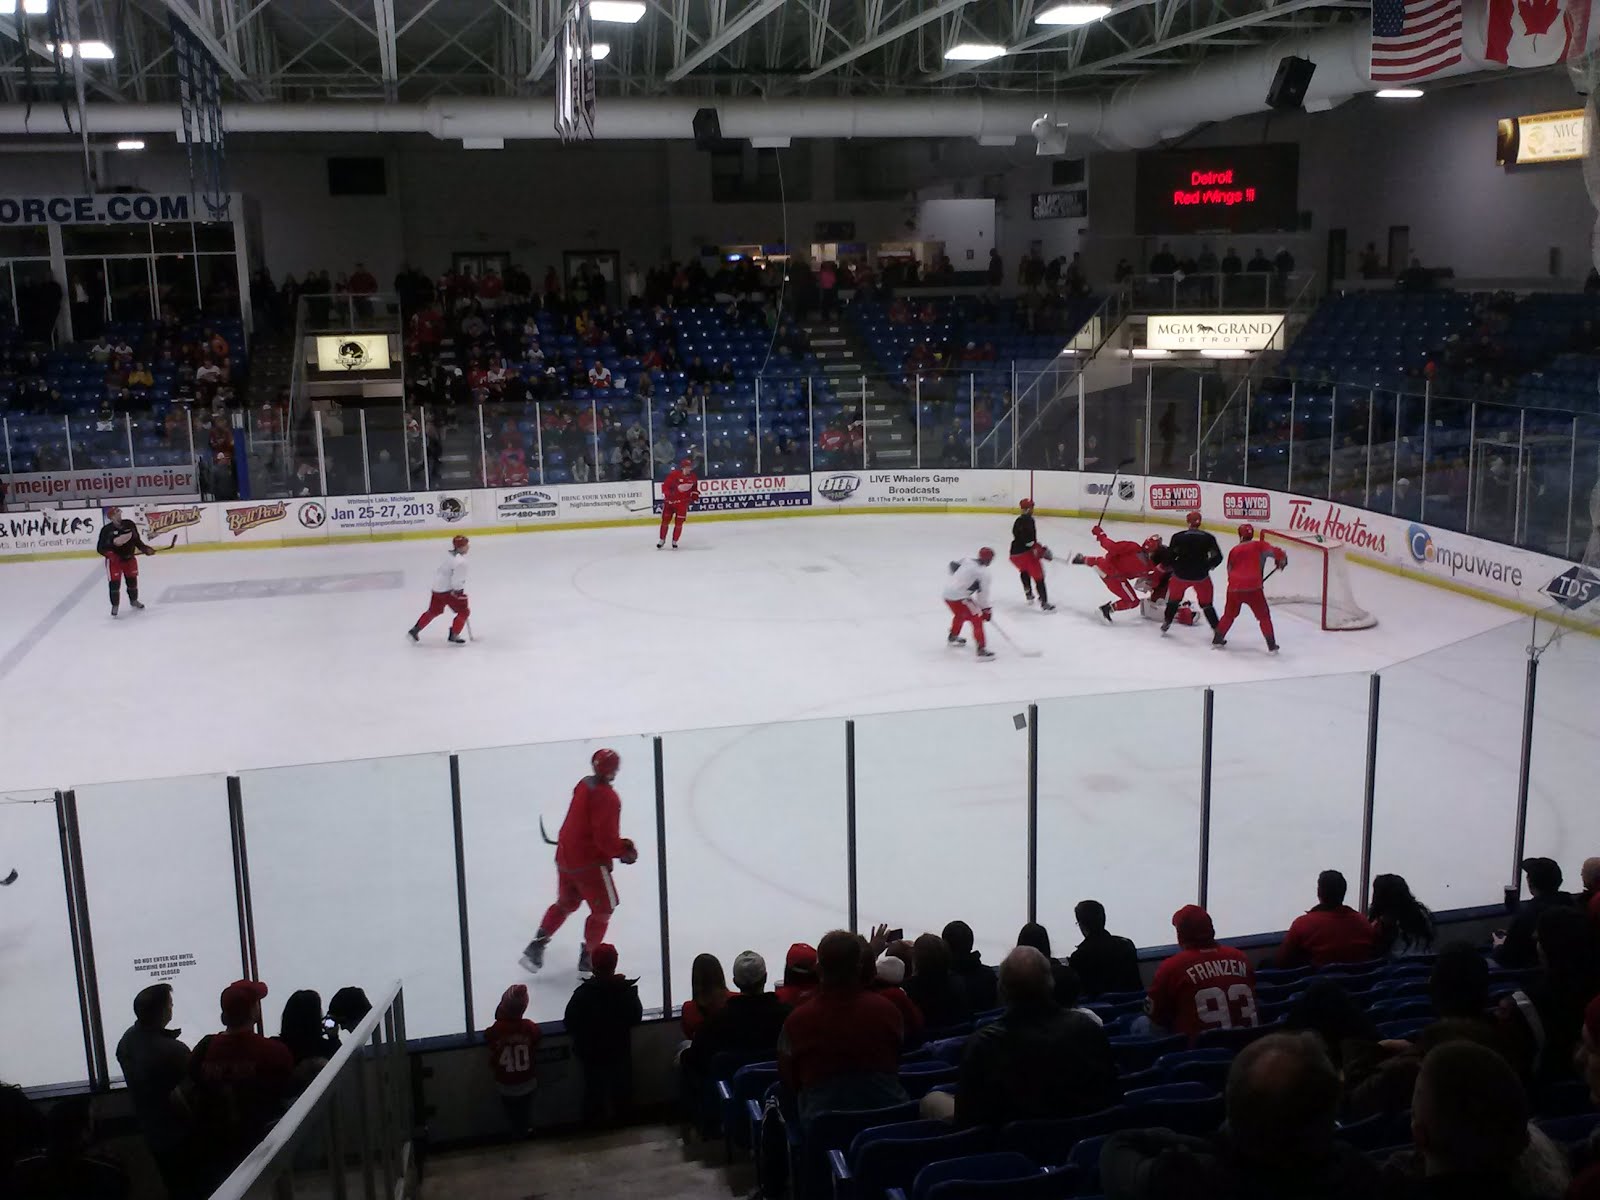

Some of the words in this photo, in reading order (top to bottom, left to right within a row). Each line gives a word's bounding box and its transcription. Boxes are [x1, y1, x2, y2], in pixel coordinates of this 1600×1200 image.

[1191, 169, 1234, 186] Detroit
[1173, 190, 1200, 205] Red
[1202, 189, 1242, 206] Wings
[0, 196, 188, 223] ORCE.COM
[1157, 324, 1193, 334] MGM
[1217, 323, 1272, 334] GRAND
[15, 476, 71, 496] meijer
[76, 473, 132, 493] meijer
[137, 470, 192, 490] meijer
[699, 477, 786, 491] OCKEY.COM
[869, 475, 891, 483] LIVE
[892, 474, 930, 483] Whalers
[932, 474, 960, 484] Game
[504, 490, 552, 503] HIGHLAND
[889, 486, 941, 494] Broadcasts
[1152, 487, 1171, 499] 99.5
[1173, 487, 1198, 499] WYCD
[700, 502, 748, 510] HOCKEY
[755, 498, 809, 507] LEAGUES
[1225, 496, 1243, 508] 99.5
[1245, 496, 1268, 509] WYCD
[169, 506, 202, 524] Park
[227, 509, 256, 531] Ball
[256, 501, 287, 520] Park
[331, 508, 355, 521] Jan
[359, 505, 400, 519] 25-27,
[404, 503, 434, 516] 2013
[10, 516, 94, 538] WHALERS
[1289, 499, 1321, 534] Tim
[1322, 504, 1385, 553] Hortons
[39, 538, 62, 547] Great
[1411, 532, 1523, 587] Compuware
[1559, 575, 1592, 600] TDS
[161, 968, 180, 976] CLOSED
[1186, 959, 1247, 984] FRANZEN
[1195, 983, 1259, 1031] 93
[500, 1044, 530, 1073] 40
